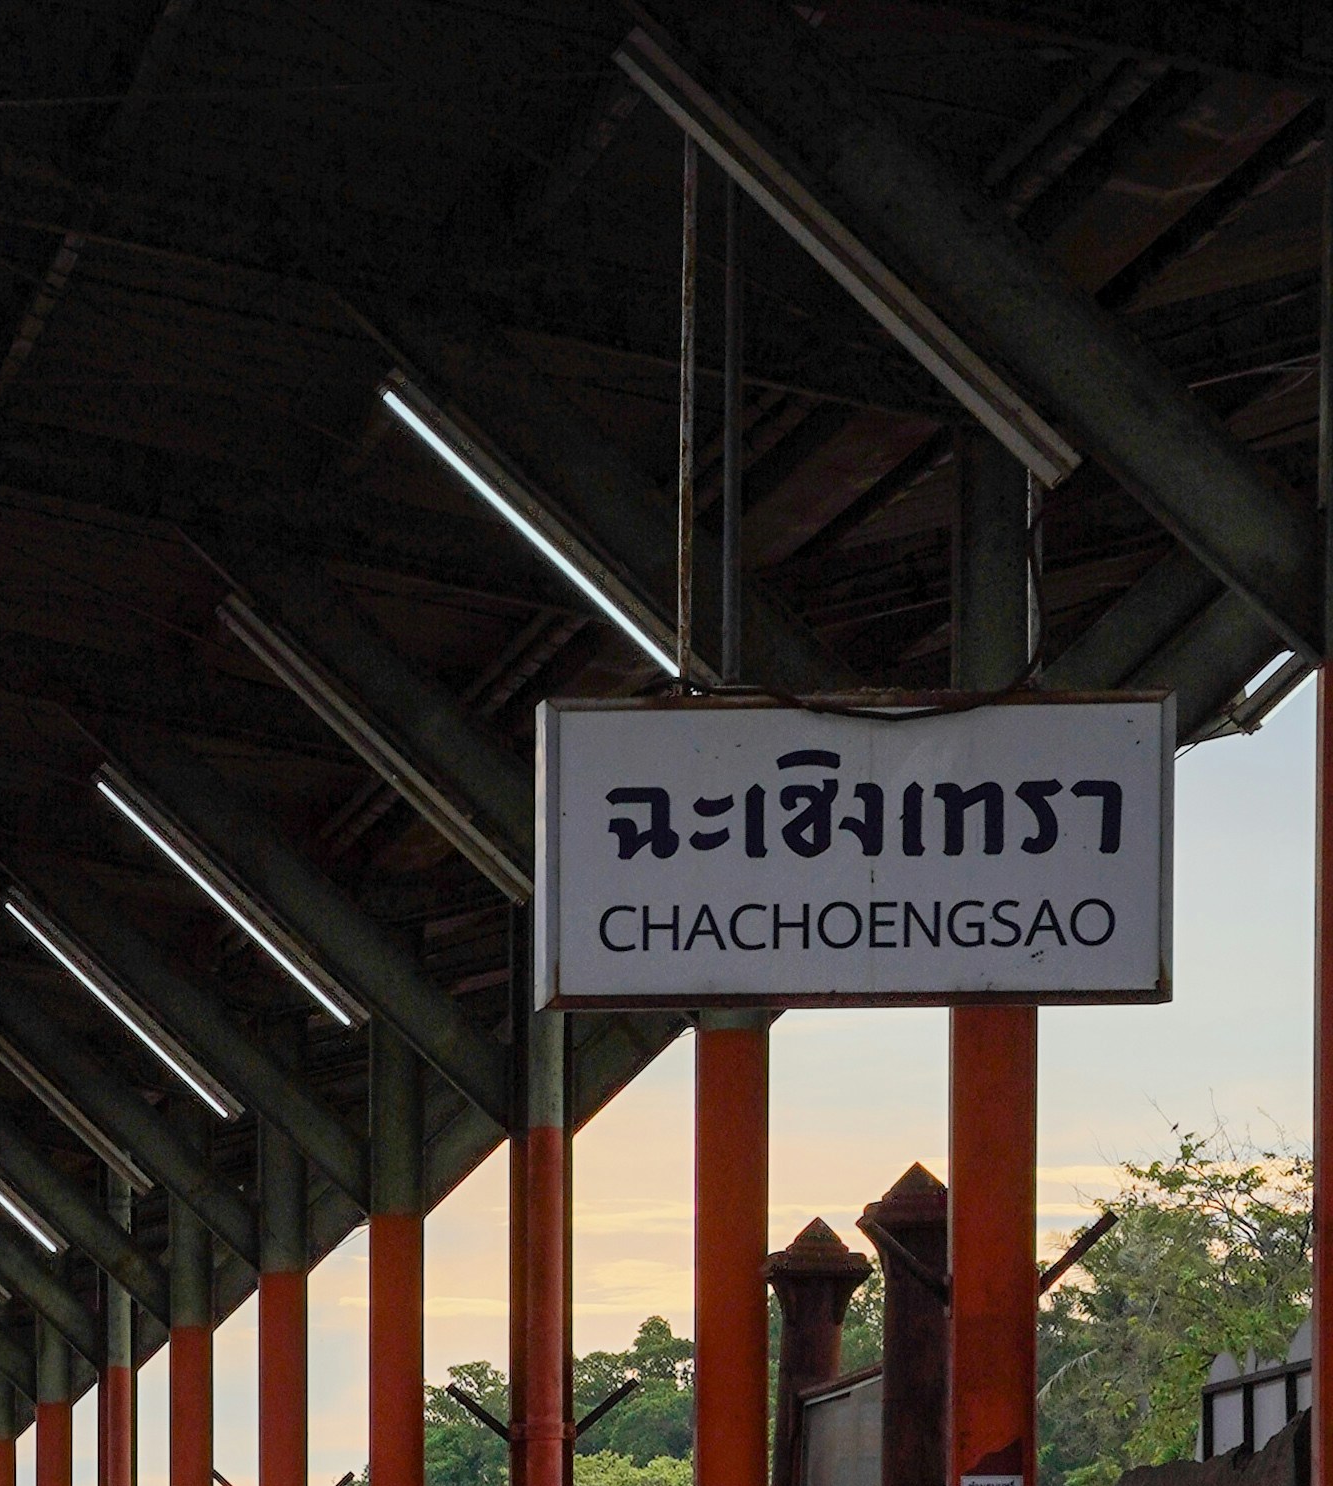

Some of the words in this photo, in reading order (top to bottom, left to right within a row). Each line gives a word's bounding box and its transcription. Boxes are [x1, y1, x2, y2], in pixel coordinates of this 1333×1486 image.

[606, 748, 1123, 859] ฉะเชิงเทรา
[599, 898, 1116, 952] CHACHOENGSAO
